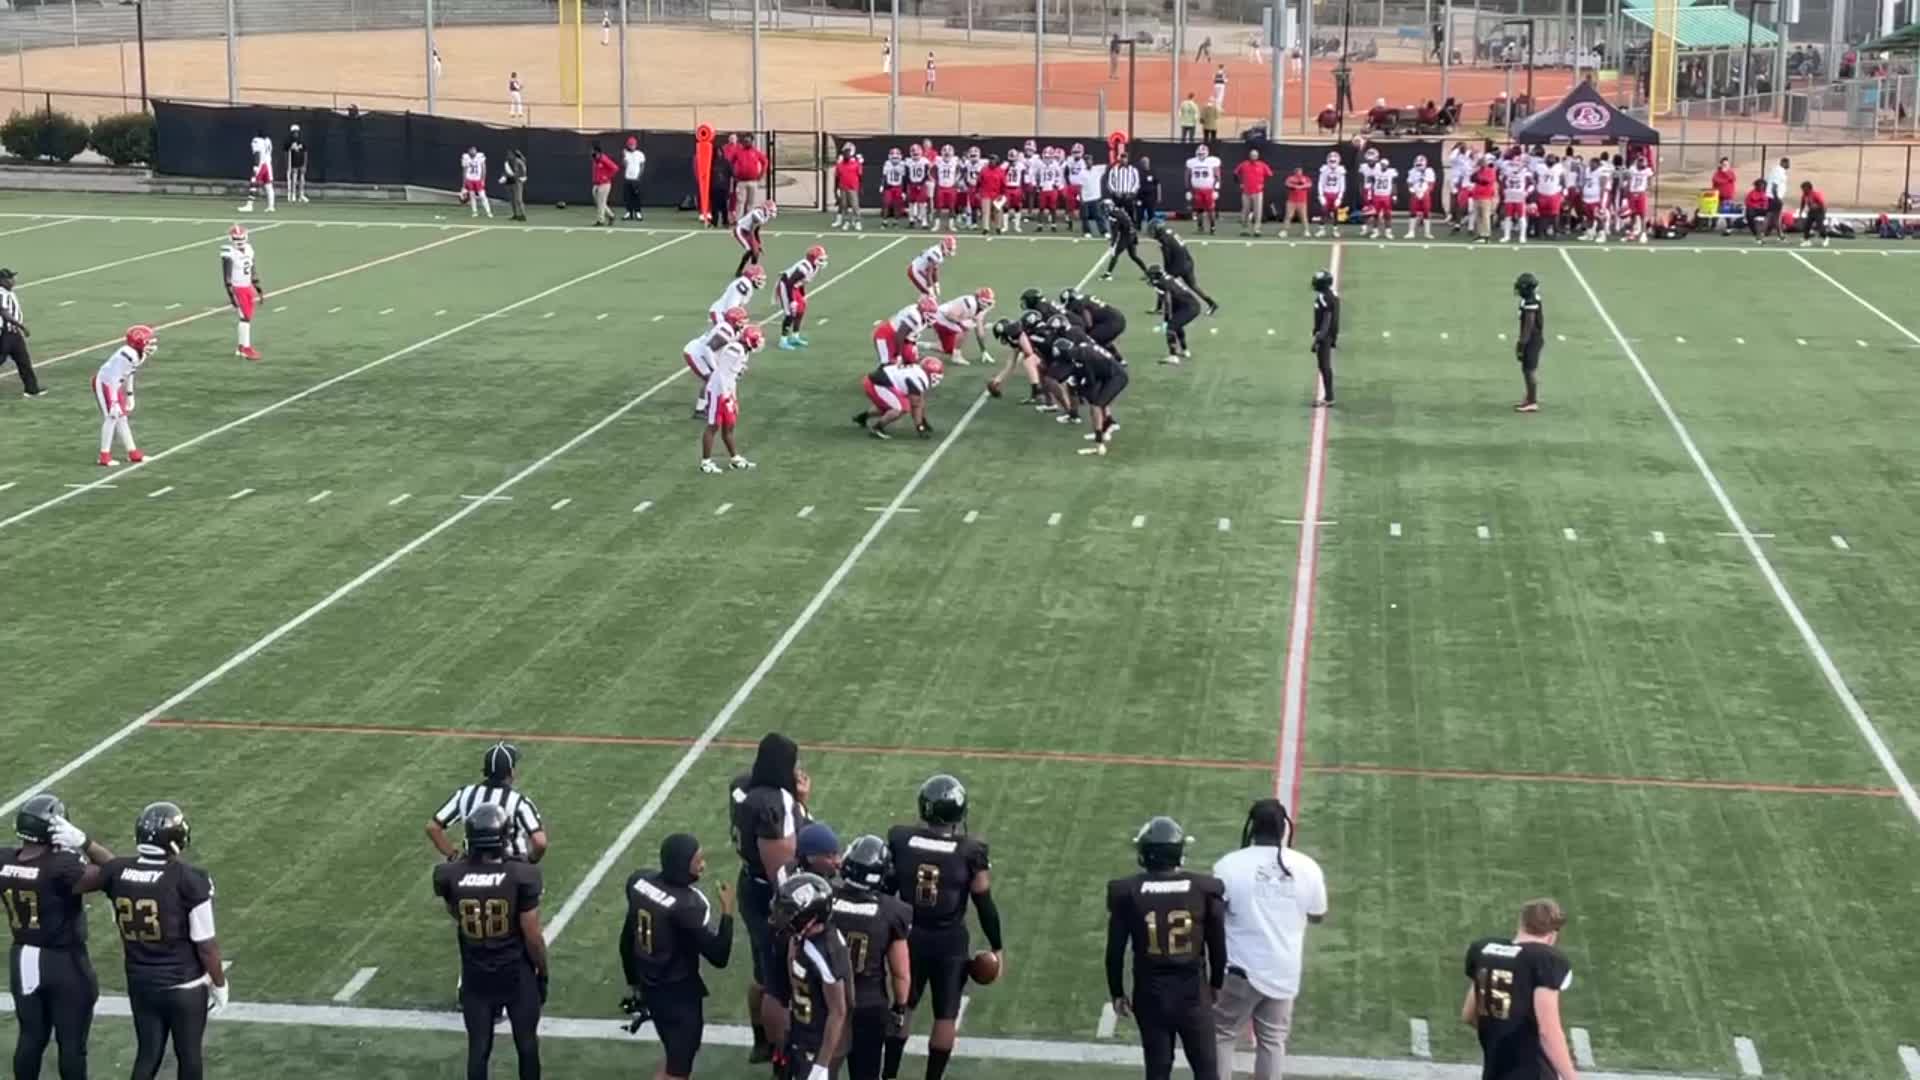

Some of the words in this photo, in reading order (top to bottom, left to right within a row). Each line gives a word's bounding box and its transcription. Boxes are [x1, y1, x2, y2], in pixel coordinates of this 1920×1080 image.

[916, 863, 940, 906] 8
[3, 888, 40, 930] 17
[115, 896, 161, 943] 23
[459, 898, 510, 939] 88
[1144, 909, 1193, 956] 12
